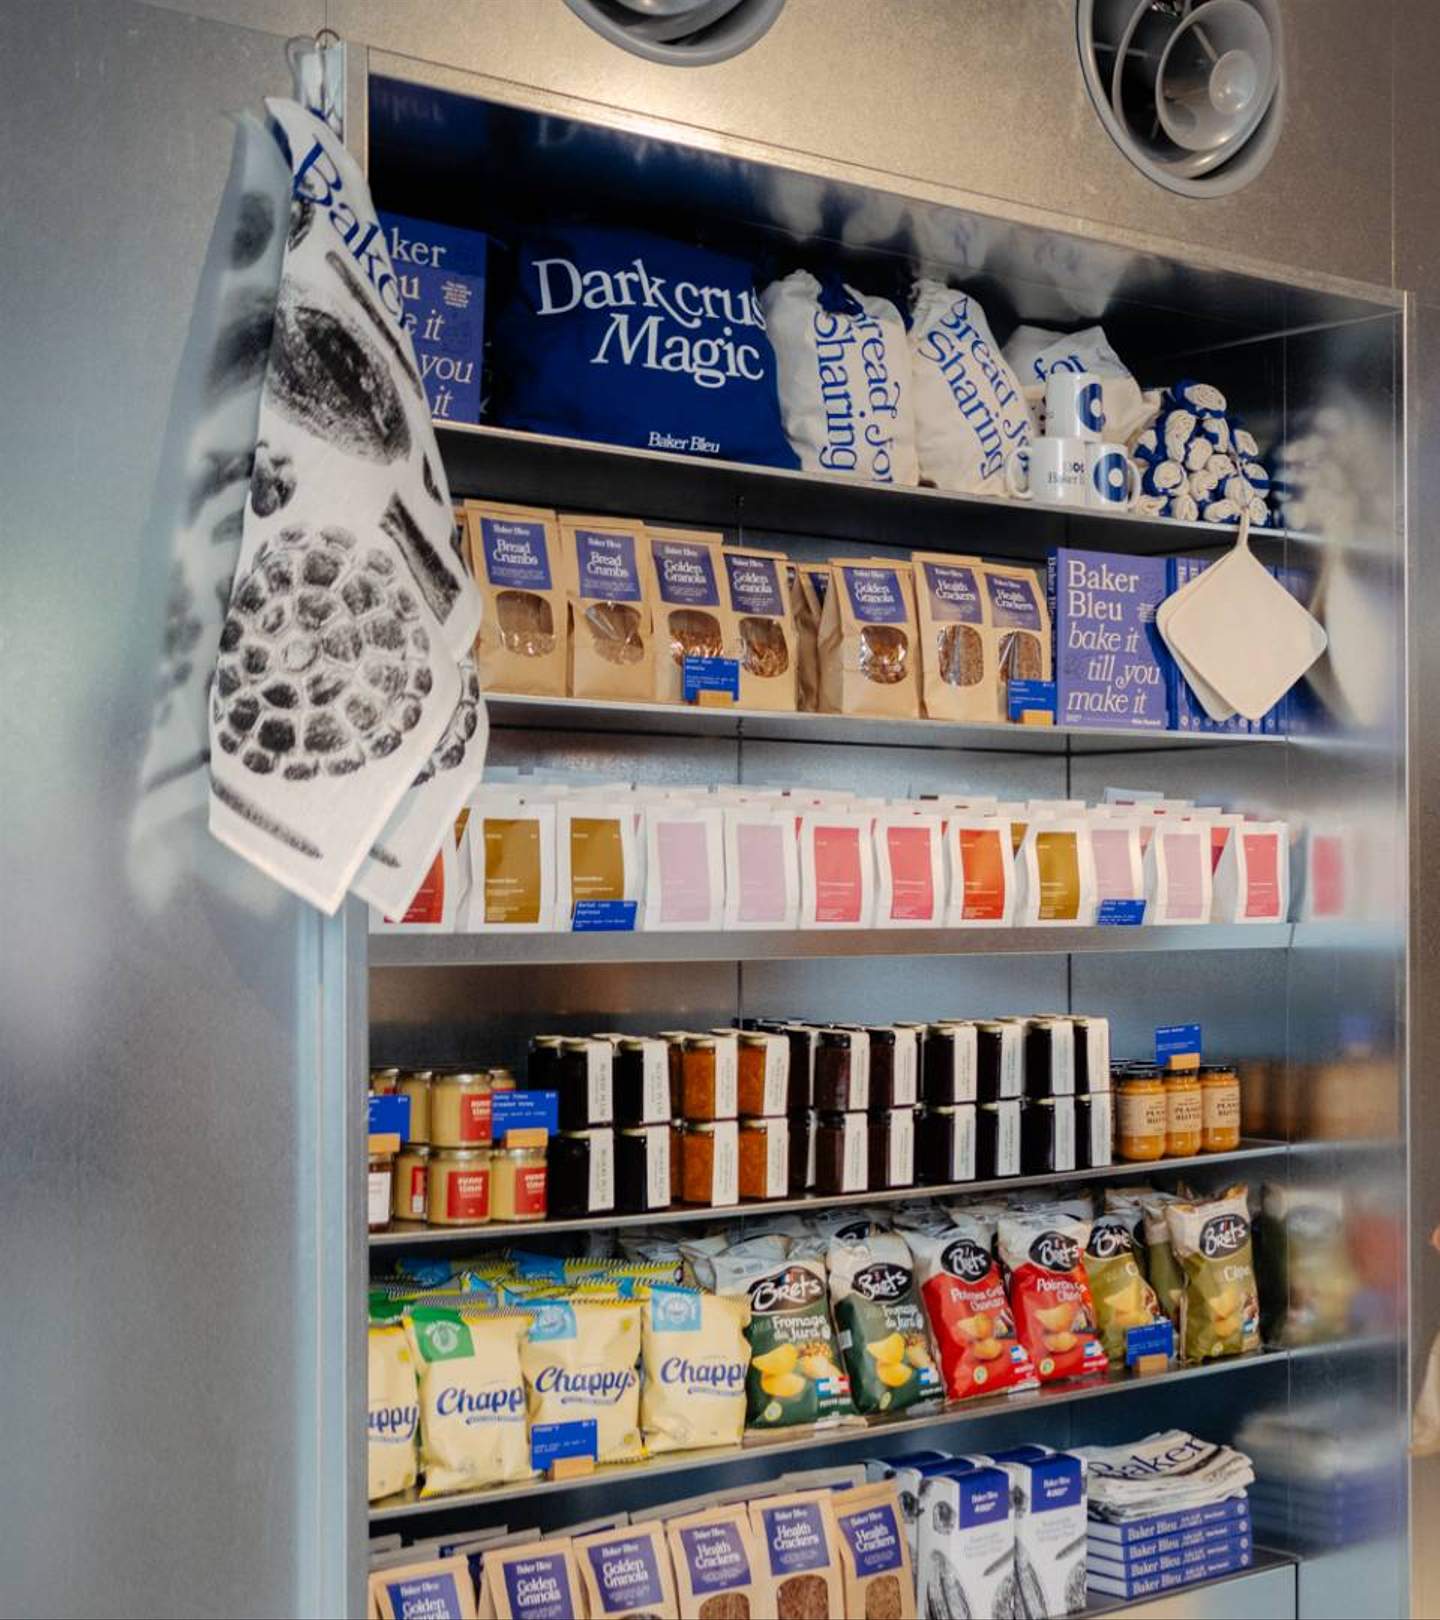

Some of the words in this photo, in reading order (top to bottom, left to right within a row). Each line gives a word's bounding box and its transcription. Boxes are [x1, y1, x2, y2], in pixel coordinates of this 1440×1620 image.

[391, 227, 447, 268] ker
[422, 309, 444, 341] it
[589, 312, 765, 389] Magic
[939, 296, 1018, 408] Bread
[420, 353, 473, 384] you
[855, 313, 900, 420] read
[813, 310, 865, 471] Sharing
[432, 385, 453, 417] it
[917, 330, 1004, 481] Sharing
[648, 431, 689, 450] Baker
[689, 435, 720, 453] Bleu
[496, 538, 531, 553] Bread
[492, 548, 538, 566] Crumbs
[590, 550, 622, 566] Bread
[663, 559, 703, 575] Golden
[587, 562, 629, 578] Crumbs
[664, 570, 707, 584] Granola
[733, 570, 768, 584] Golden
[1067, 560, 1139, 593] Baker
[732, 580, 773, 594] Granola
[854, 581, 890, 595] Golden
[935, 588, 976, 601] Crackers
[937, 579, 969, 592] Health
[995, 598, 1034, 611] Crackers
[1067, 590, 1122, 622] Bleu
[1069, 621, 1121, 651] bake
[1126, 627, 1140, 653] it
[1087, 654, 1116, 682] till
[1115, 663, 1160, 689] you
[1067, 685, 1129, 713] make
[1133, 688, 1147, 714] it
[1092, 1228, 1132, 1257] Bre
[753, 1273, 822, 1311] Brets
[772, 1315, 826, 1329] Fromage
[791, 1325, 819, 1342] Jura
[661, 1357, 746, 1391] Chapp
[436, 1386, 525, 1416] Chapp
[369, 1405, 418, 1439] appy
[1088, 1437, 1204, 1481] Baker
[776, 1523, 812, 1540] Health
[855, 1525, 889, 1543] Health
[1128, 1525, 1155, 1542] Baker
[1156, 1521, 1178, 1535] Bleu
[696, 1540, 732, 1557] Health
[774, 1534, 820, 1551] Crackers
[855, 1535, 896, 1552] Crackers
[1130, 1544, 1157, 1560] Baker
[1158, 1539, 1179, 1553] Bleu
[603, 1557, 645, 1577] Golden
[695, 1552, 741, 1570] Crackers
[1131, 1561, 1158, 1577] Baker
[1160, 1556, 1180, 1571] Bleu
[517, 1577, 557, 1592] Golden
[603, 1569, 649, 1589] Granola
[1133, 1580, 1159, 1595] Baker
[1161, 1573, 1182, 1588] Bleu
[402, 1597, 446, 1614] Golden
[517, 1588, 562, 1607] Granola
